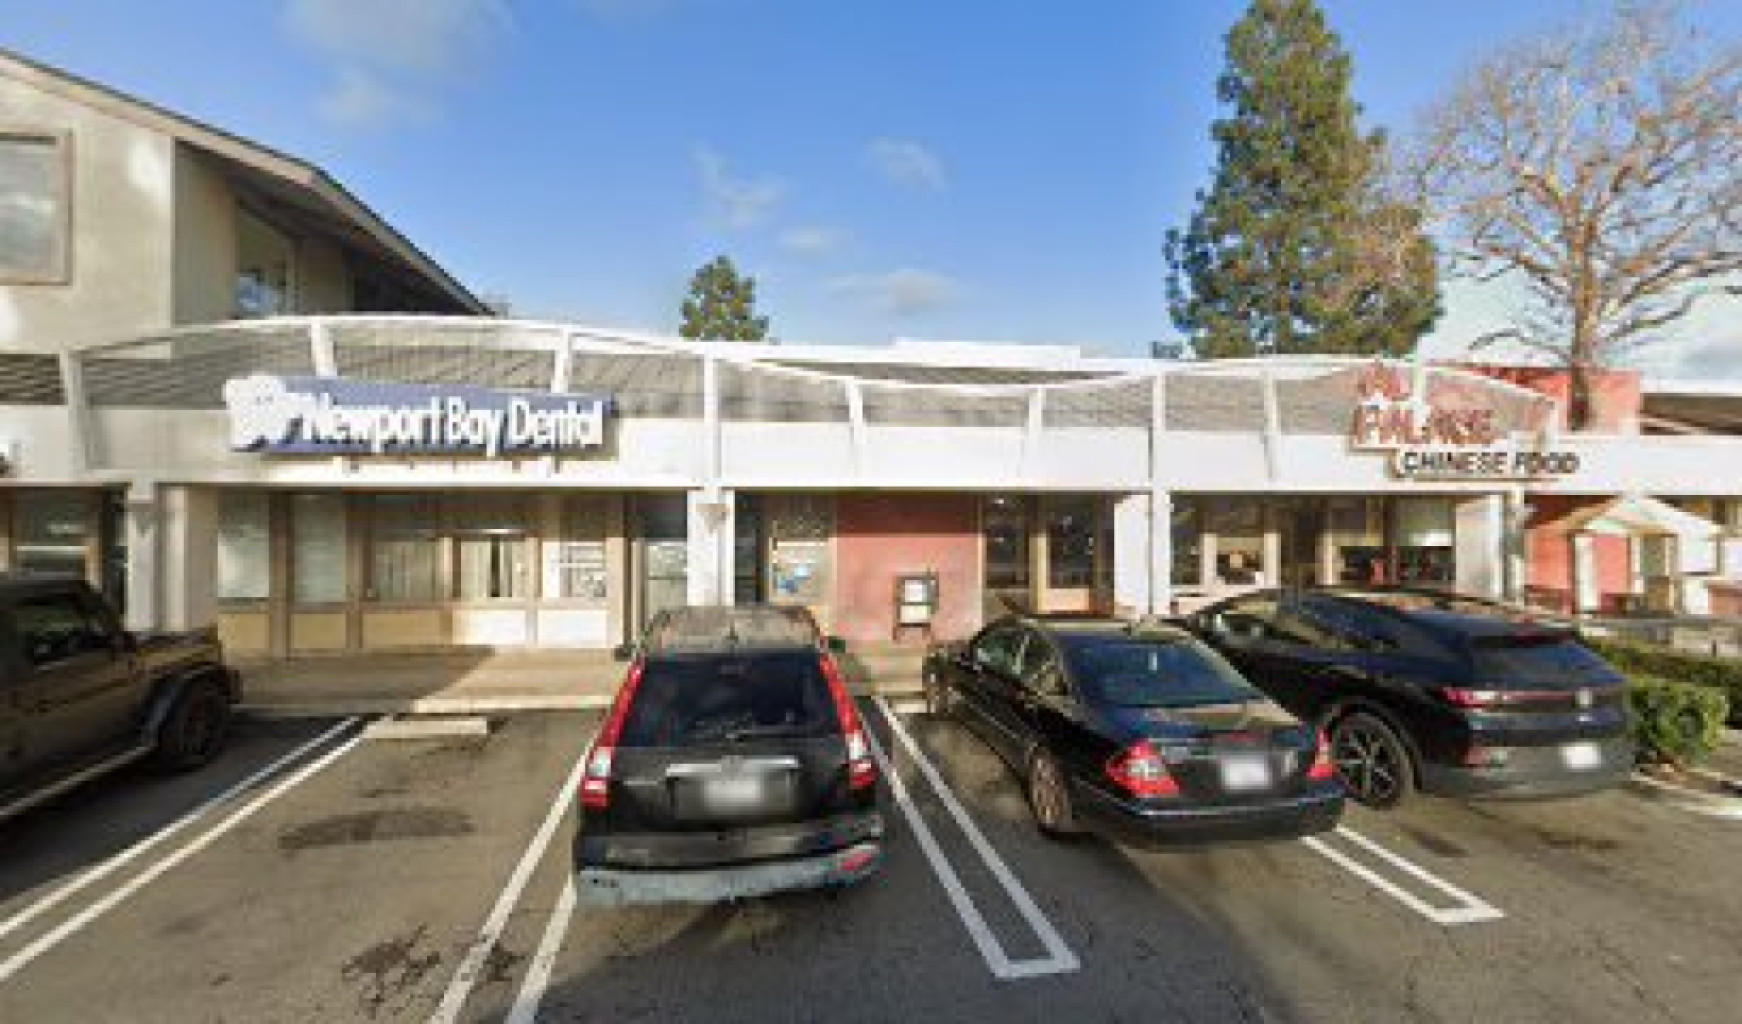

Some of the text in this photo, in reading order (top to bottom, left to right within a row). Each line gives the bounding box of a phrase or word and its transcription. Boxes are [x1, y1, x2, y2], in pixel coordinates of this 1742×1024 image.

[303, 393, 603, 458] Newport Bay Dental
[1403, 451, 1579, 475] CHINESE FOOD
